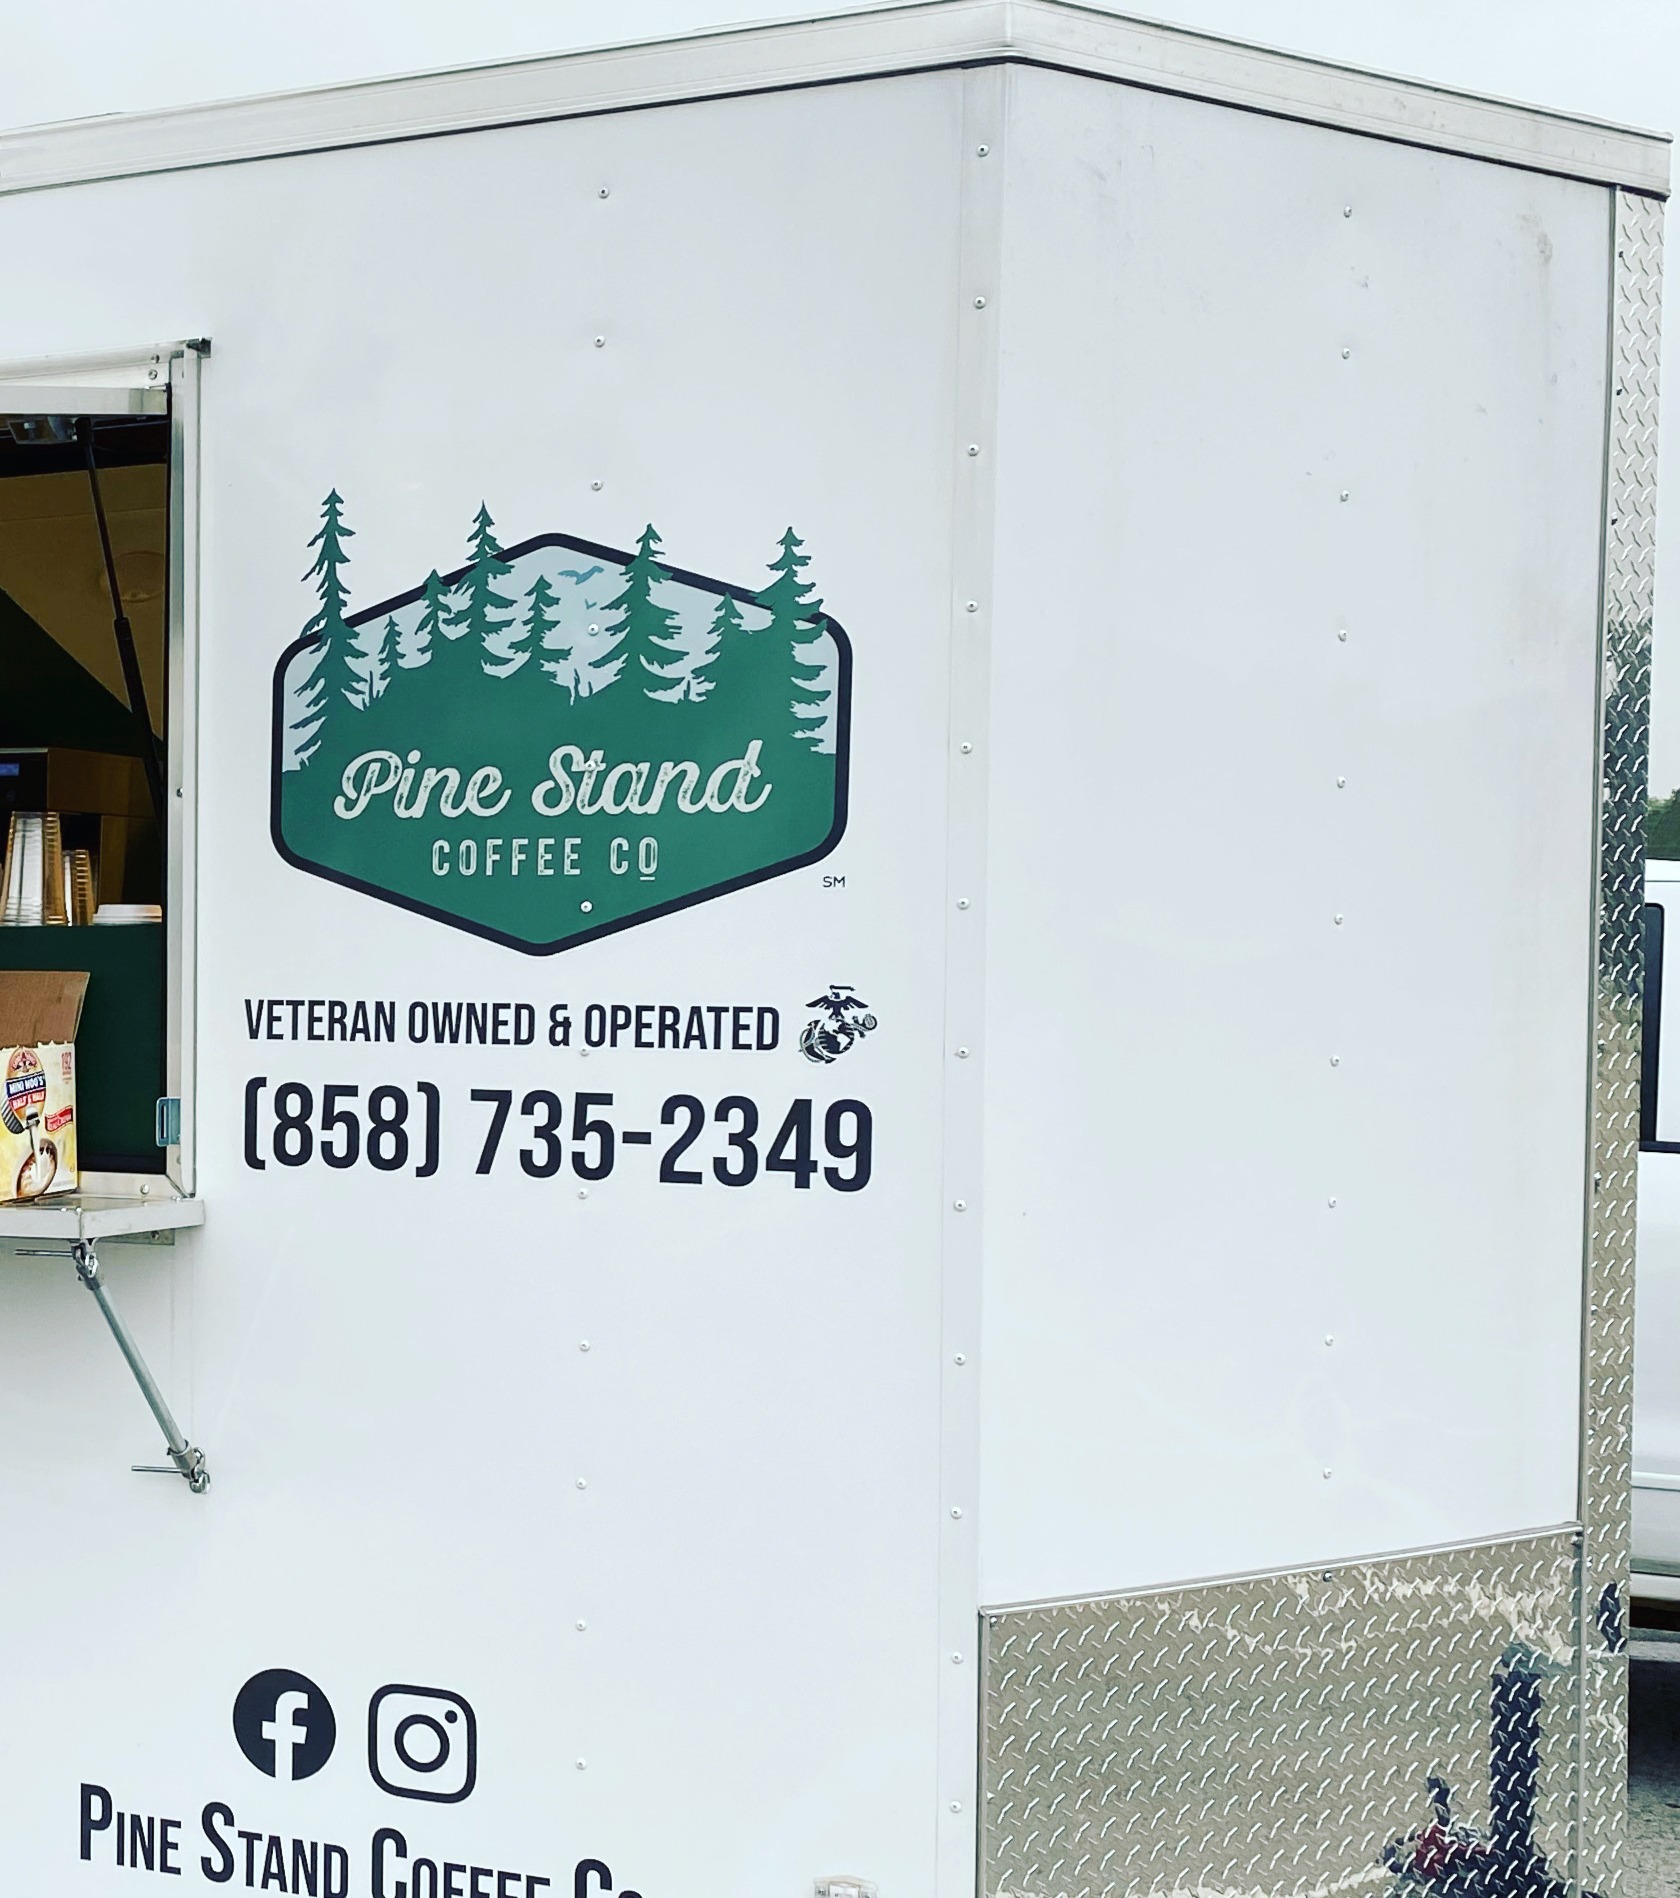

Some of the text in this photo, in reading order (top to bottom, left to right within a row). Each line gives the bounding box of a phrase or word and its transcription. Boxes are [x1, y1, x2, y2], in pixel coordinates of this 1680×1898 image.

[332, 739, 773, 820] Pine Stand
[431, 836, 659, 880] COFFEE CO
[822, 875, 846, 888] SM
[244, 998, 780, 1051] VETERAN OWNED & OPERATED
[244, 1076, 874, 1193] (858) 735-2349
